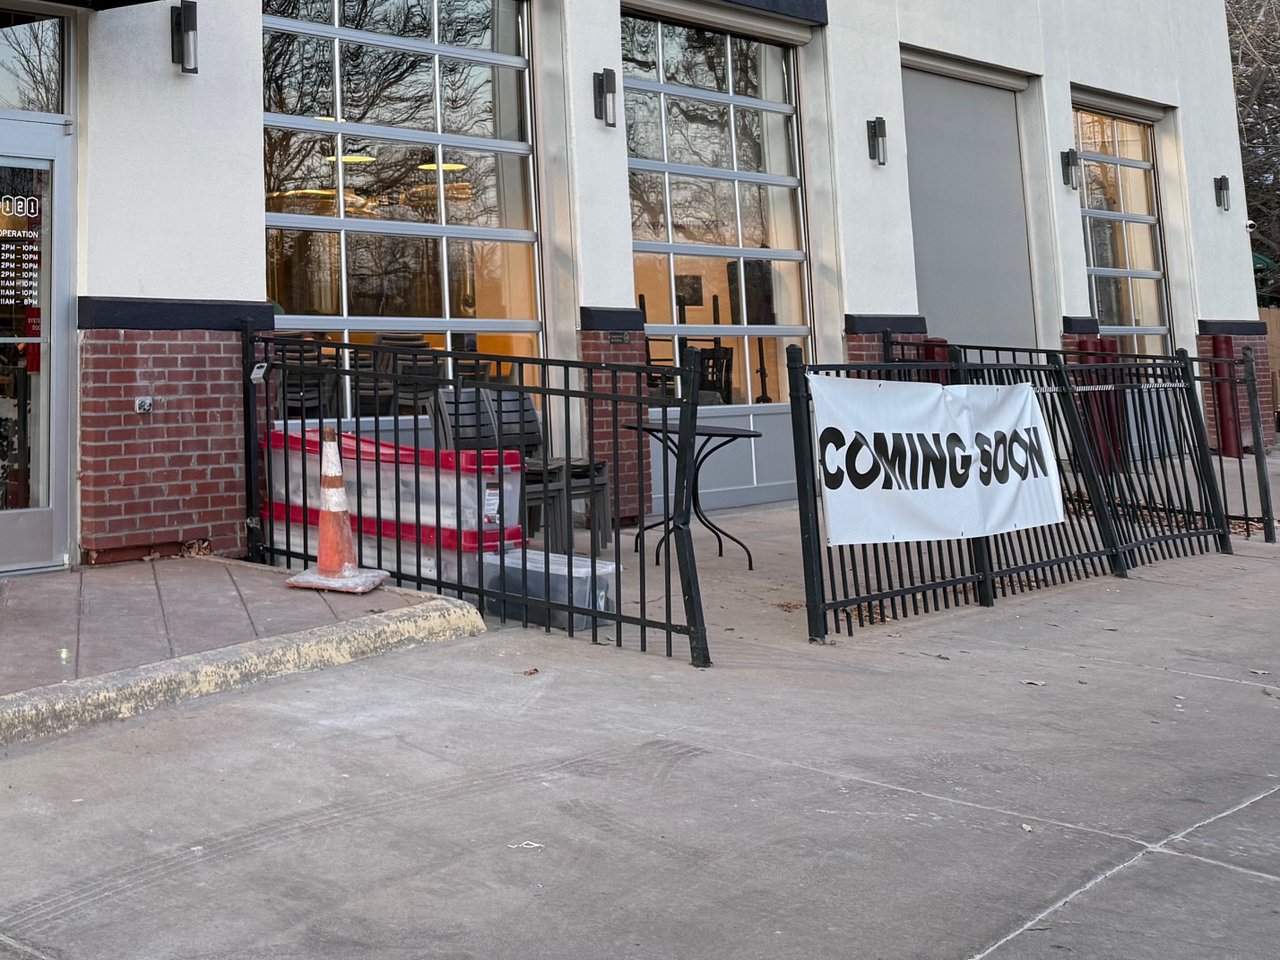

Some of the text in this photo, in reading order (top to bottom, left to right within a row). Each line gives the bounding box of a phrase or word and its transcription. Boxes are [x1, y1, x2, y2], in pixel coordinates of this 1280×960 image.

[21, 280, 38, 288] 10PM
[21, 289, 38, 297] 10PM
[819, 426, 1049, 491] COMING SOON
